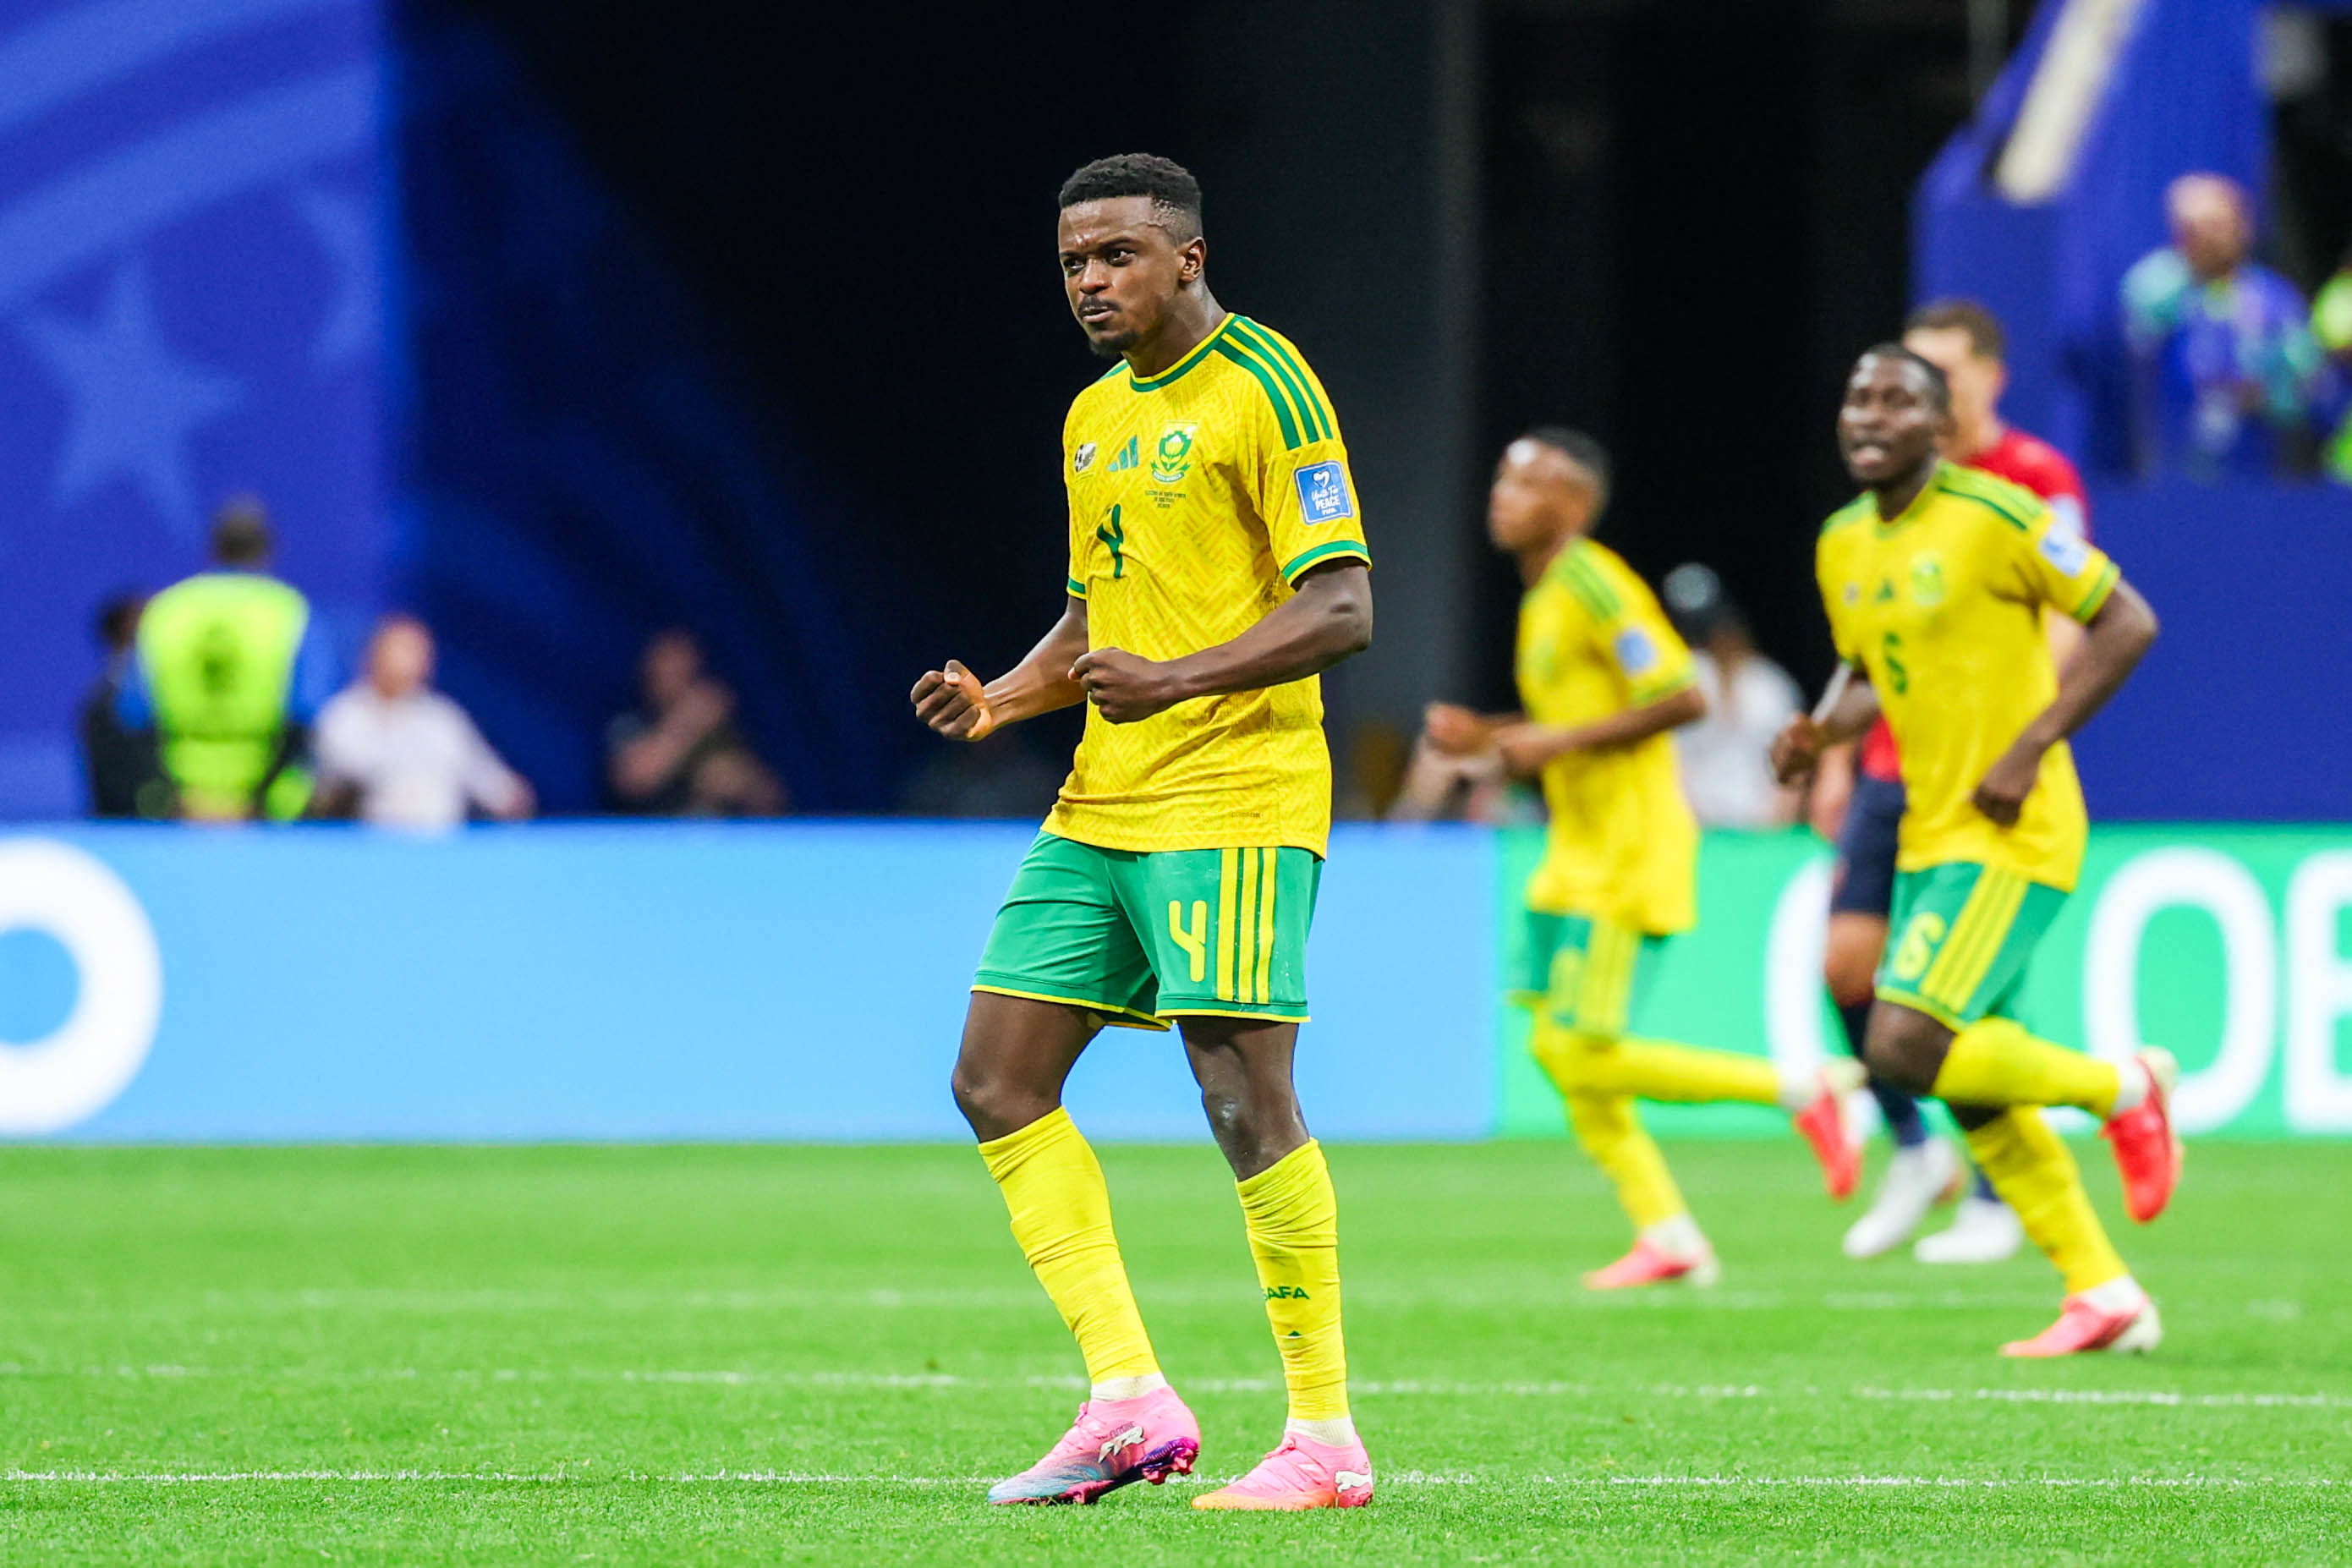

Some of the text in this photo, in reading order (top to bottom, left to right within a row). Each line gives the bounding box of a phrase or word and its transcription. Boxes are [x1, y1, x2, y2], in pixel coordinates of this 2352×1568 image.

[1314, 495, 1340, 511] PEACE
[1097, 504, 1124, 578] 4
[1168, 900, 1207, 983] 4
[1894, 911, 1945, 980] 6
[1264, 1286, 1309, 1300] AFA
